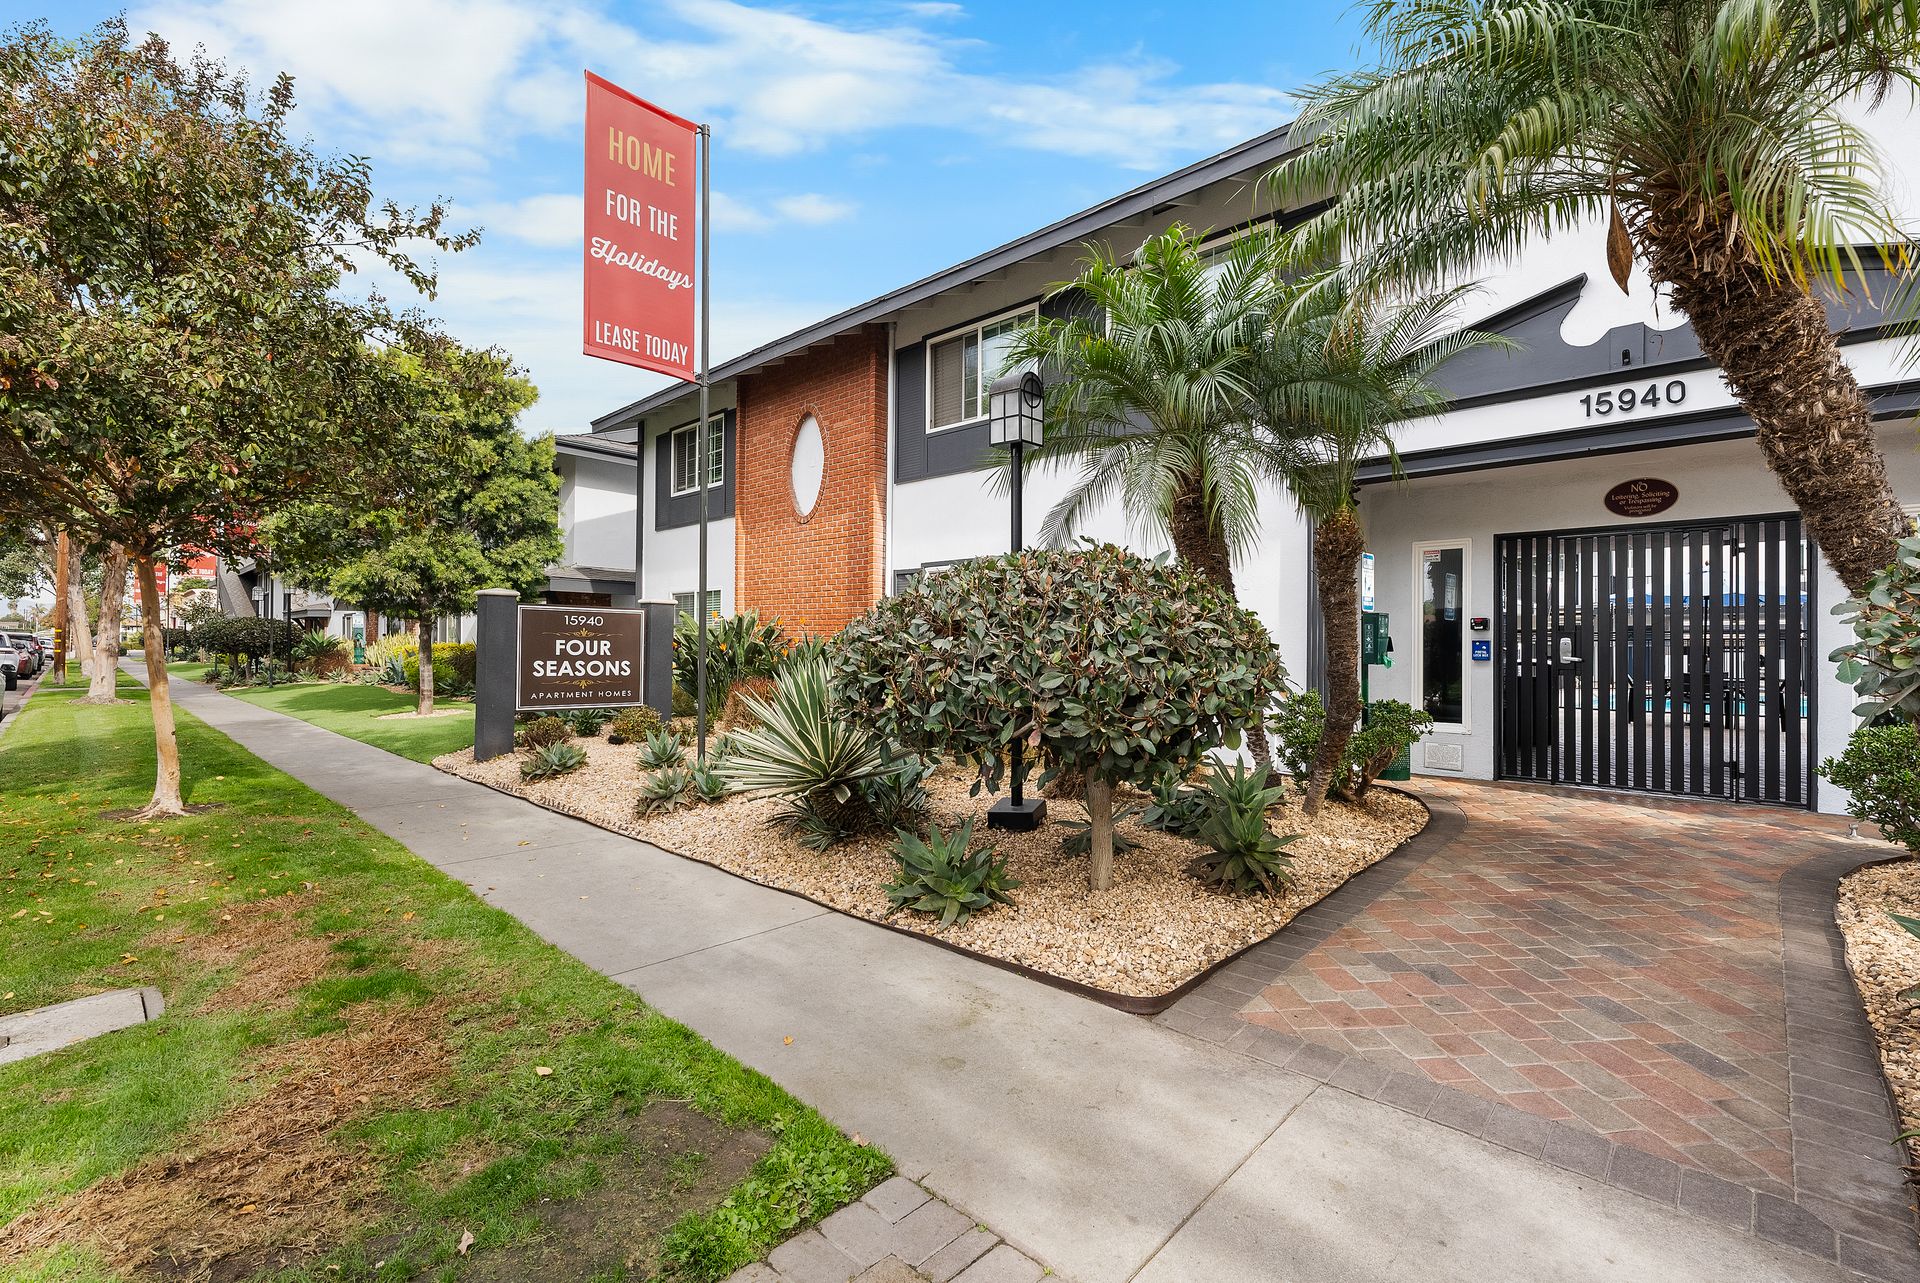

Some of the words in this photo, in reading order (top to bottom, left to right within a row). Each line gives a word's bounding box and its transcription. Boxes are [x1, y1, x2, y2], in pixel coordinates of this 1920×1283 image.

[608, 126, 676, 186] HOME
[606, 188, 641, 227] FOR
[648, 204, 678, 241] THE
[590, 236, 694, 290] Holidays
[595, 320, 640, 352] LEASE
[645, 332, 688, 365] TODAY
[1580, 380, 1686, 417] 15940
[1630, 483, 1648, 492] NO
[564, 615, 604, 626] 15940
[555, 639, 611, 656] FOUR
[532, 660, 631, 677] SEASONS
[530, 691, 593, 699] APARTMENT
